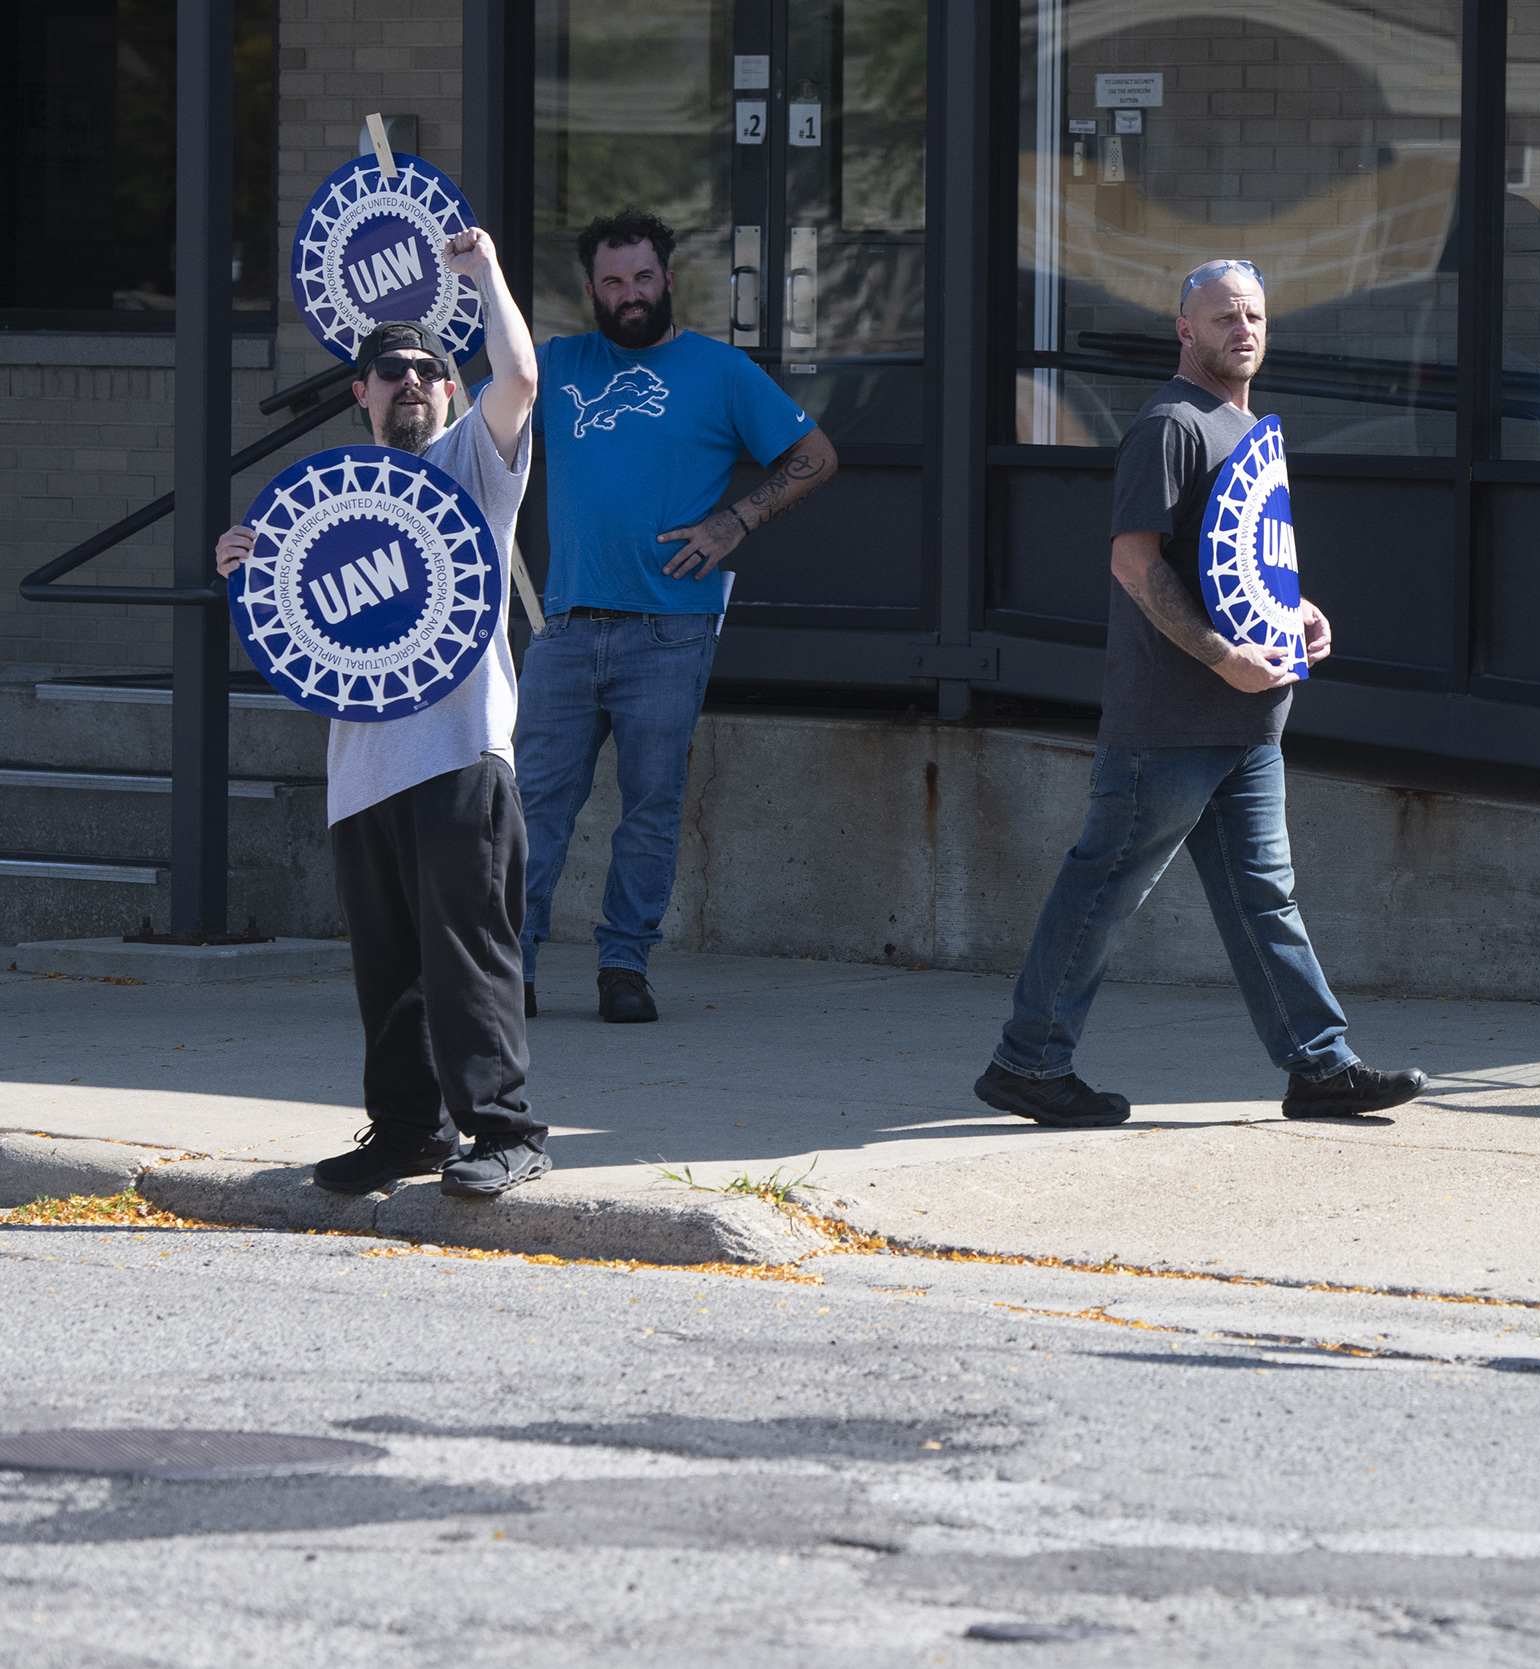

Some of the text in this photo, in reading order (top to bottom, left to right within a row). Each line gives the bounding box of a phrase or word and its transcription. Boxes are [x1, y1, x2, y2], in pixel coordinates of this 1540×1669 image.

[743, 114, 761, 137] #2
[798, 117, 816, 139] #1
[337, 203, 368, 236] AMERICA
[367, 197, 398, 209] UNITED
[399, 200, 443, 248] AUTOMOBILE,
[331, 233, 341, 248] OF
[326, 249, 339, 297] WORKERS
[347, 236, 424, 303] UAW
[435, 302, 449, 322] AND
[1240, 492, 1259, 539] WORKERS
[279, 498, 448, 670] UNITED AUTOMOBILE, AEROSPACE AND AGRICULTURAL IMPLEMENT WORKERS OF AMERICA
[308, 540, 410, 625] UAW
[1240, 543, 1261, 602] IMPLEMENT
